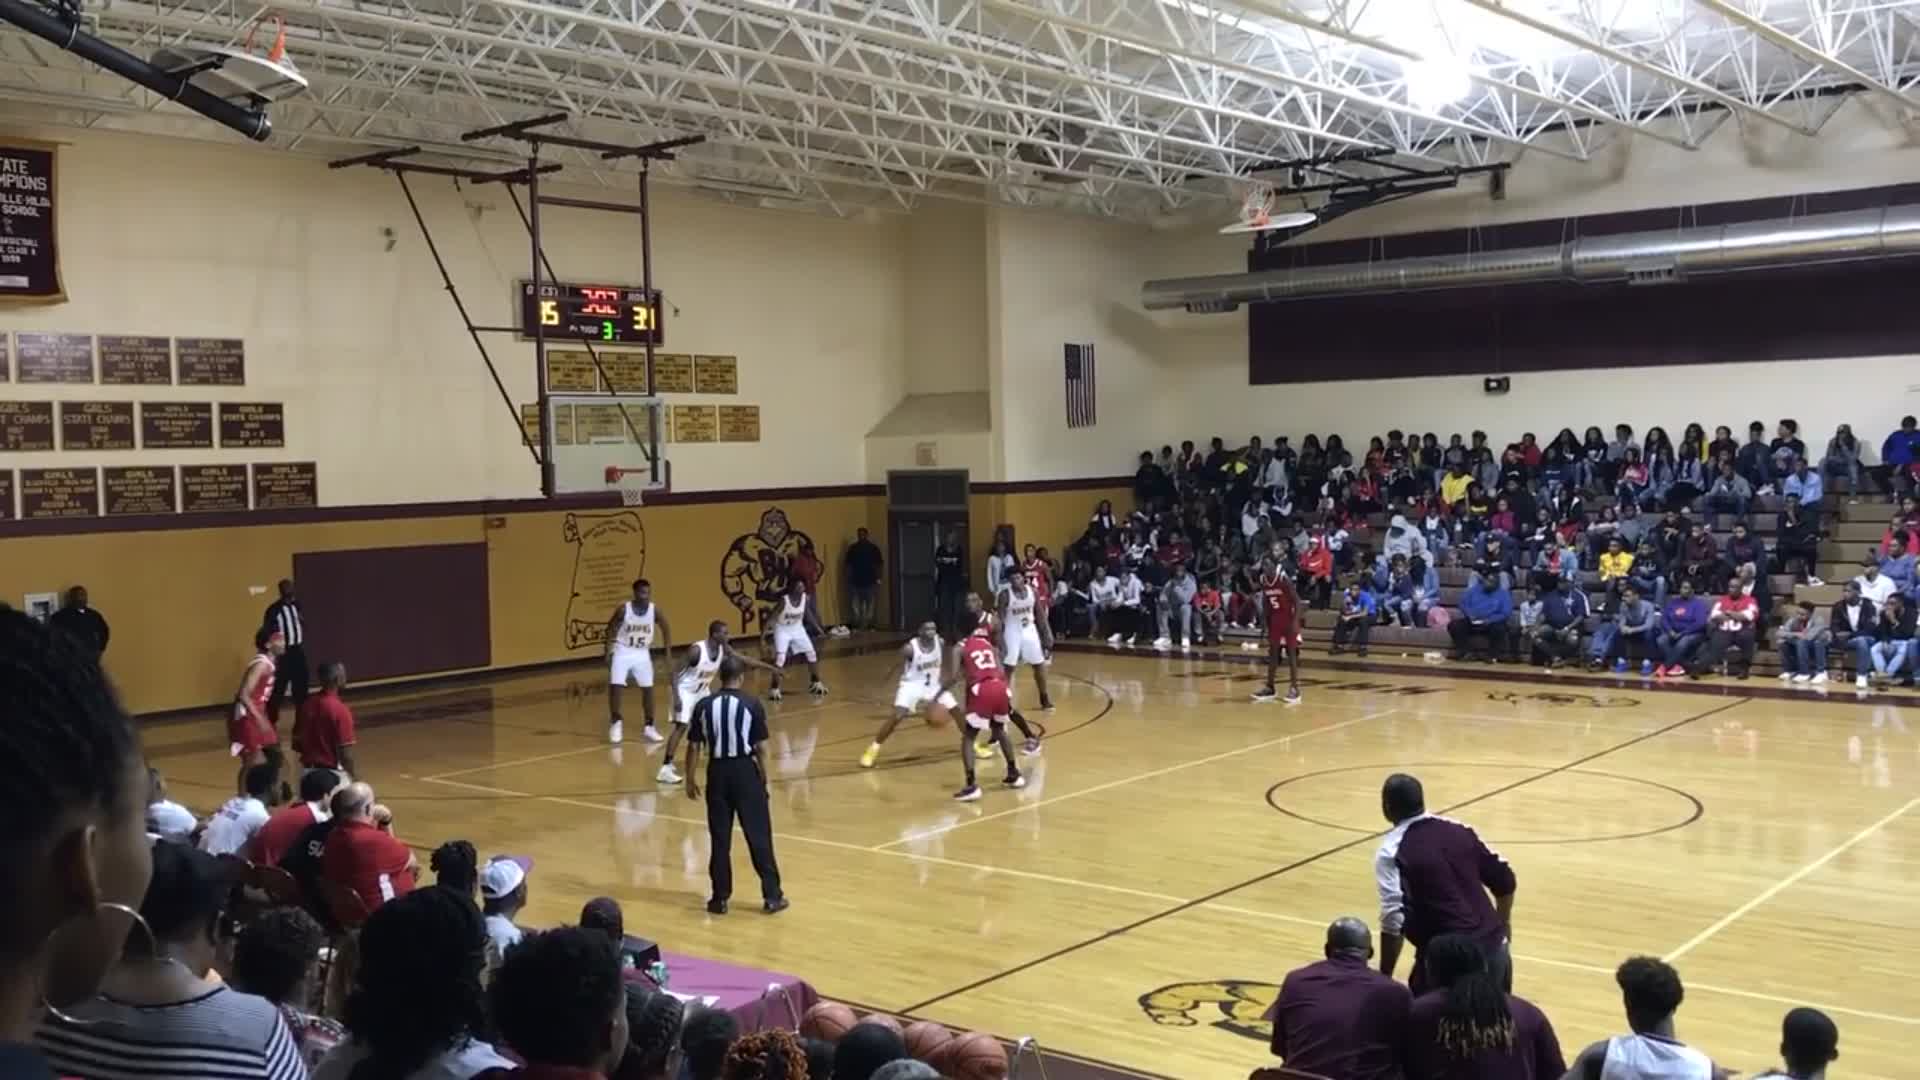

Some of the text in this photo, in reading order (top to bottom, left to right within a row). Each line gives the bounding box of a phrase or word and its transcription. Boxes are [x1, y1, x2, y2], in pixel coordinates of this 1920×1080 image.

[0, 157, 29, 174] ATE
[602, 321, 614, 340] 3
[1269, 595, 1281, 609] 5
[628, 636, 647, 648] 15
[971, 649, 997, 670] 23
